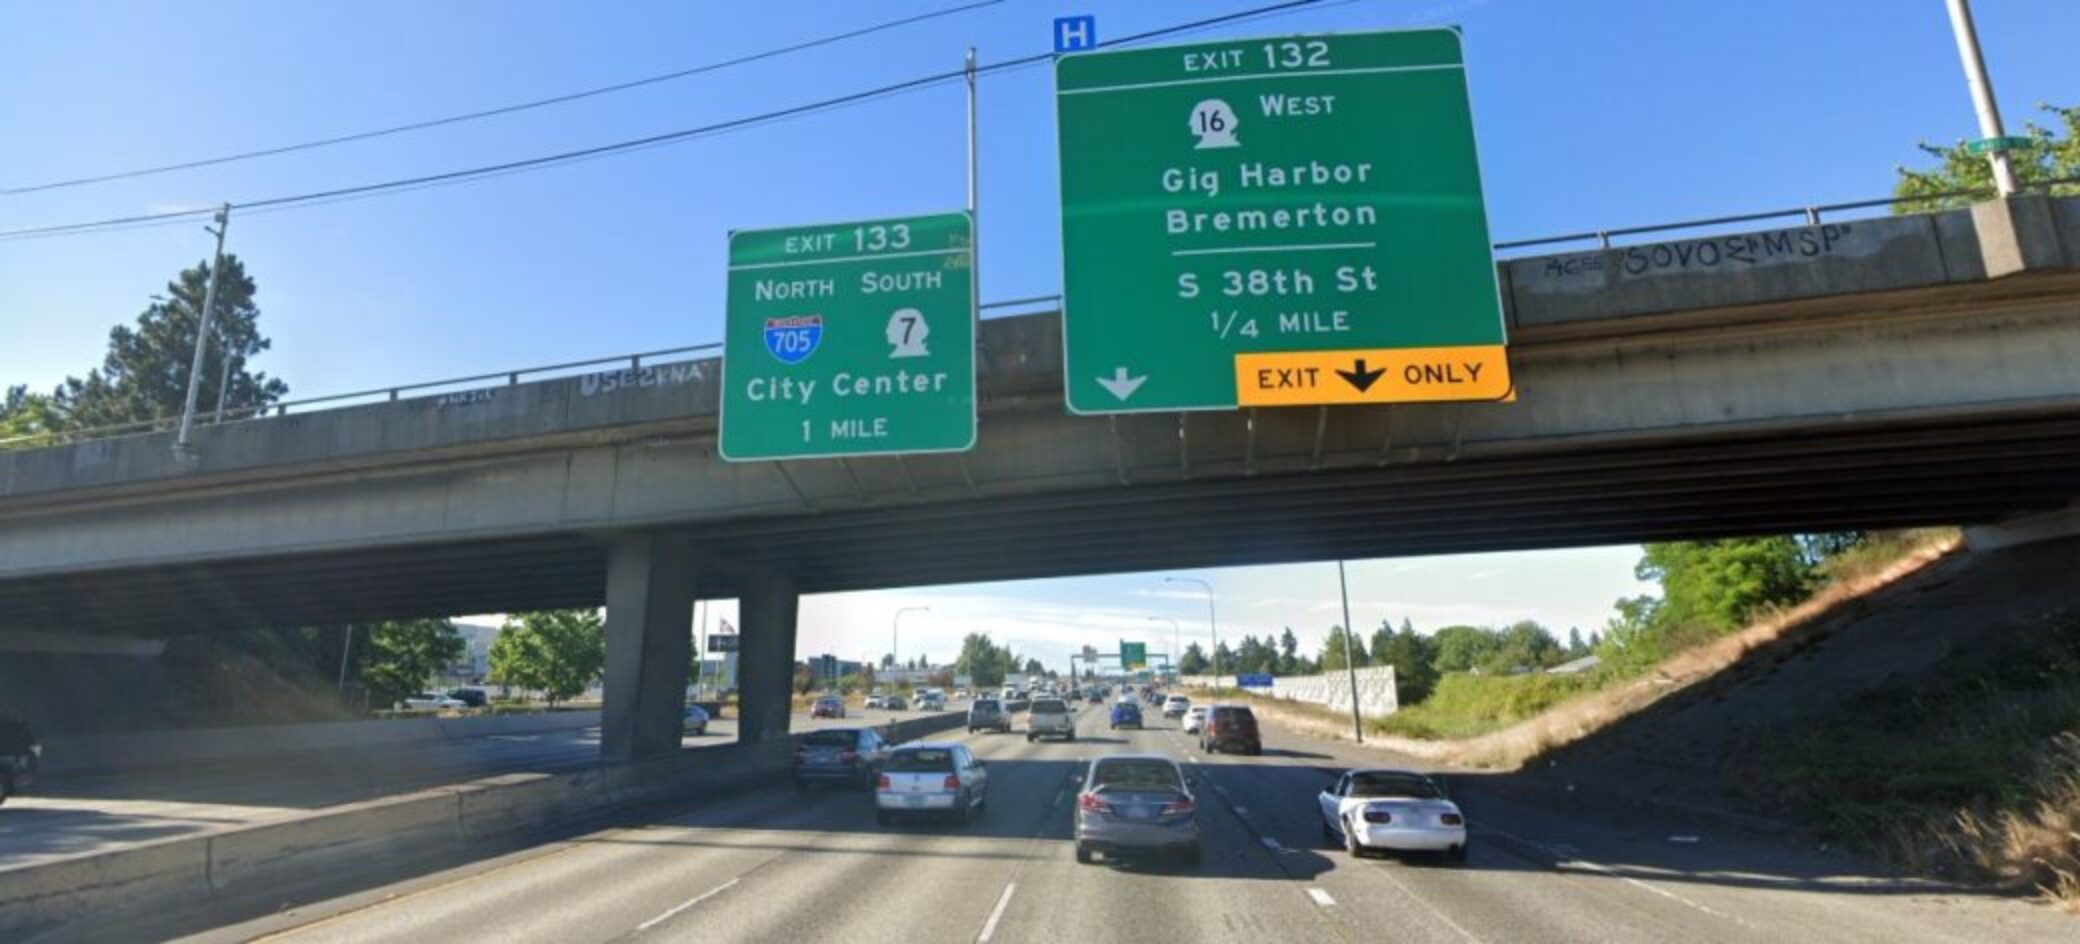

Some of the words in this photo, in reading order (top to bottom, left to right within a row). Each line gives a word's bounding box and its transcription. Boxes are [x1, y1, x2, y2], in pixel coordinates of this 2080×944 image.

[1059, 21, 1088, 48] H
[1183, 49, 1244, 71] EXIT
[1262, 41, 1331, 69] 132
[1260, 95, 1336, 117] WEST
[1199, 109, 1225, 134] 16
[1162, 167, 1219, 197] Gig
[1240, 160, 1372, 189] Harbor
[1166, 205, 1377, 234] Bremerton
[785, 233, 837, 254] EXIT
[854, 223, 911, 252] 133
[755, 279, 834, 301] NORTH
[861, 271, 942, 293] SOUTH
[1178, 273, 1201, 298] S
[1222, 268, 1314, 296] 38th
[1336, 265, 1377, 292] St
[901, 316, 917, 345] 7
[1210, 310, 1259, 339] 1/4
[1279, 310, 1351, 333] MILE
[773, 330, 811, 352] 705
[747, 376, 817, 404] City
[832, 370, 948, 396] Center
[1257, 367, 1320, 389] EXIT
[1404, 362, 1483, 385] ONLY
[803, 419, 811, 442] 1
[831, 418, 888, 439] MILE
